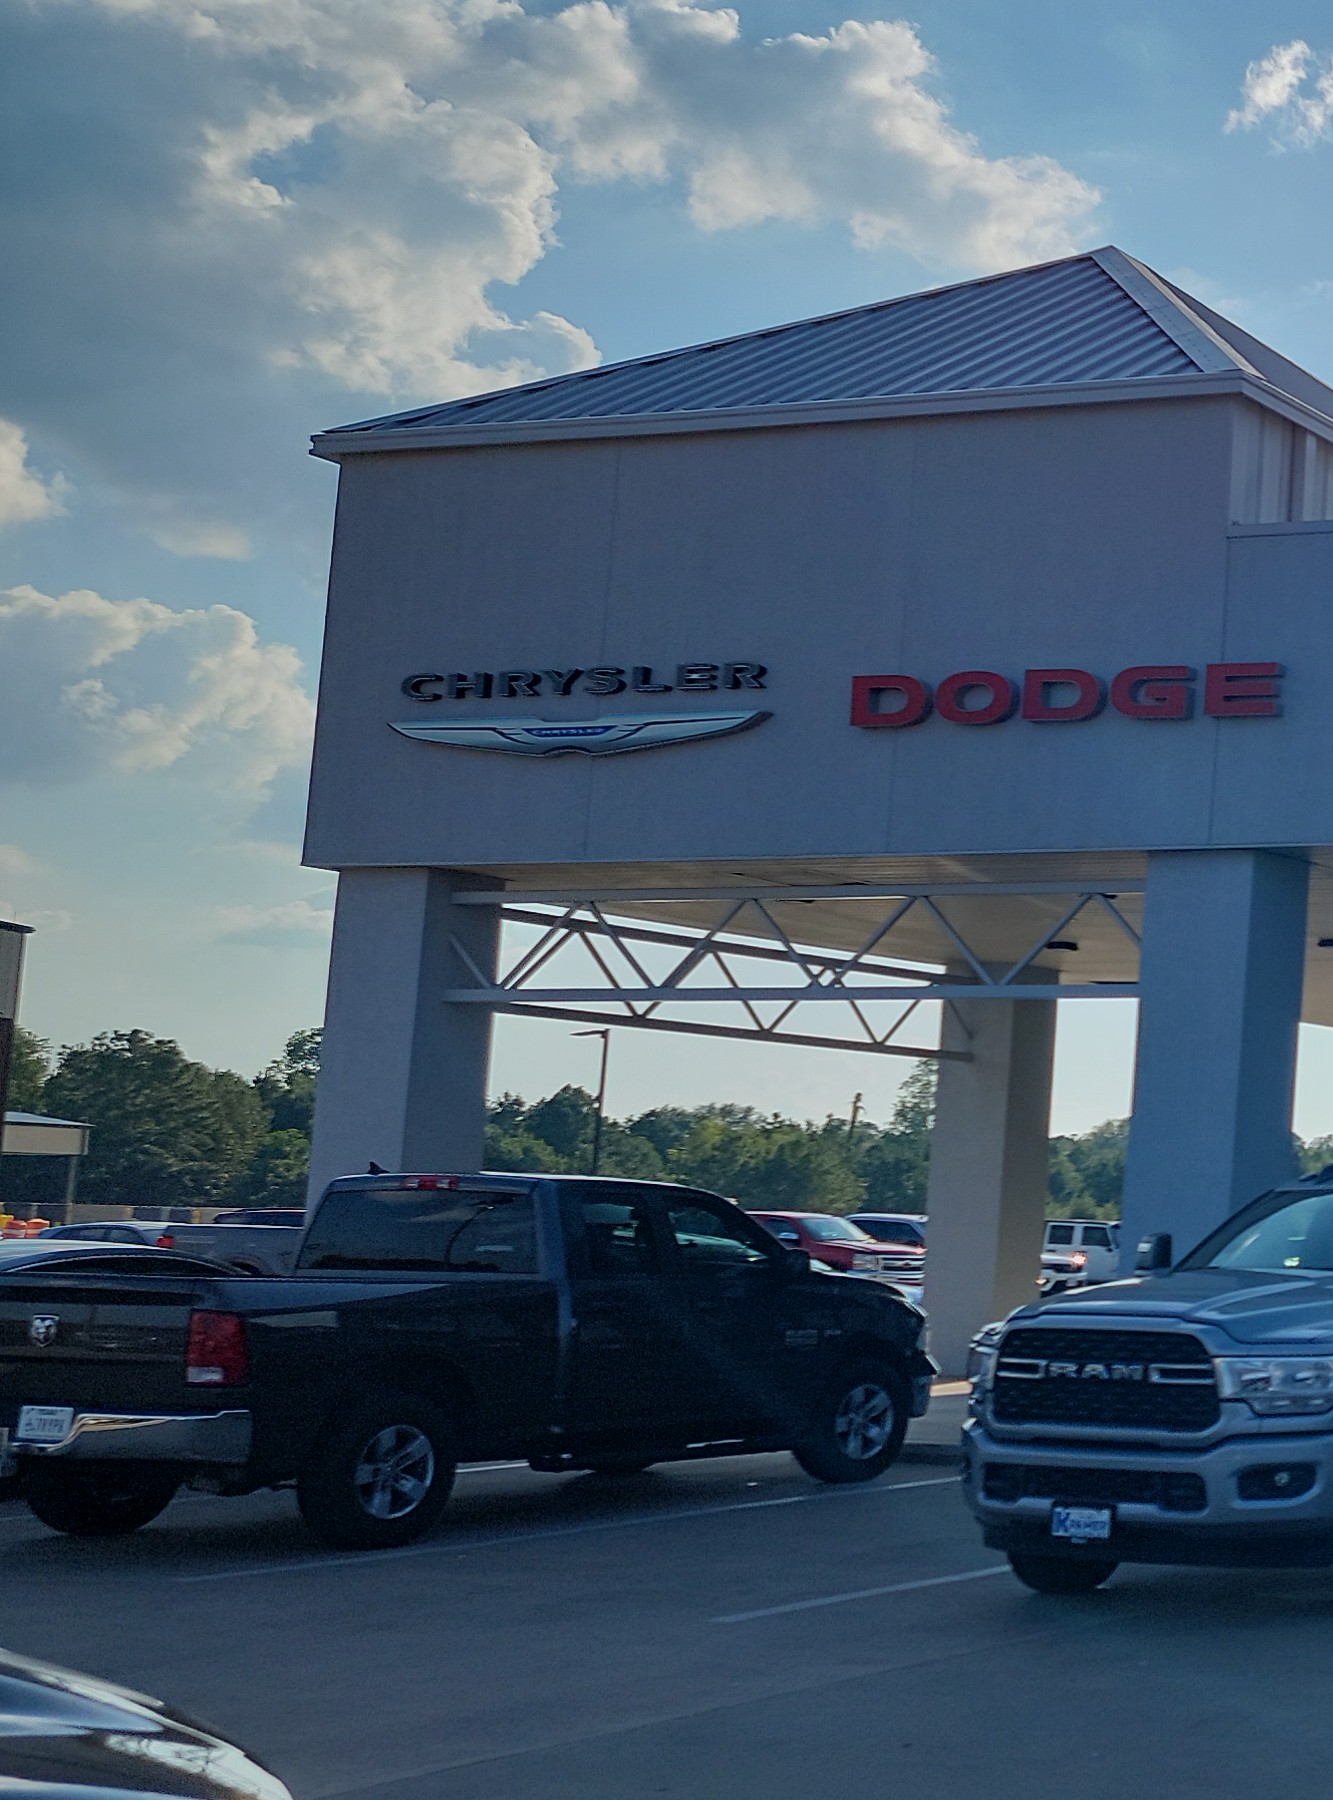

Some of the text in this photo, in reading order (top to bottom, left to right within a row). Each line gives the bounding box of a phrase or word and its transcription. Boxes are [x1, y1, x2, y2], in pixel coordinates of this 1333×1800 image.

[401, 661, 768, 701] CHRYSLER
[850, 662, 1284, 728] DODGE
[1048, 1361, 1143, 1380] RAM
